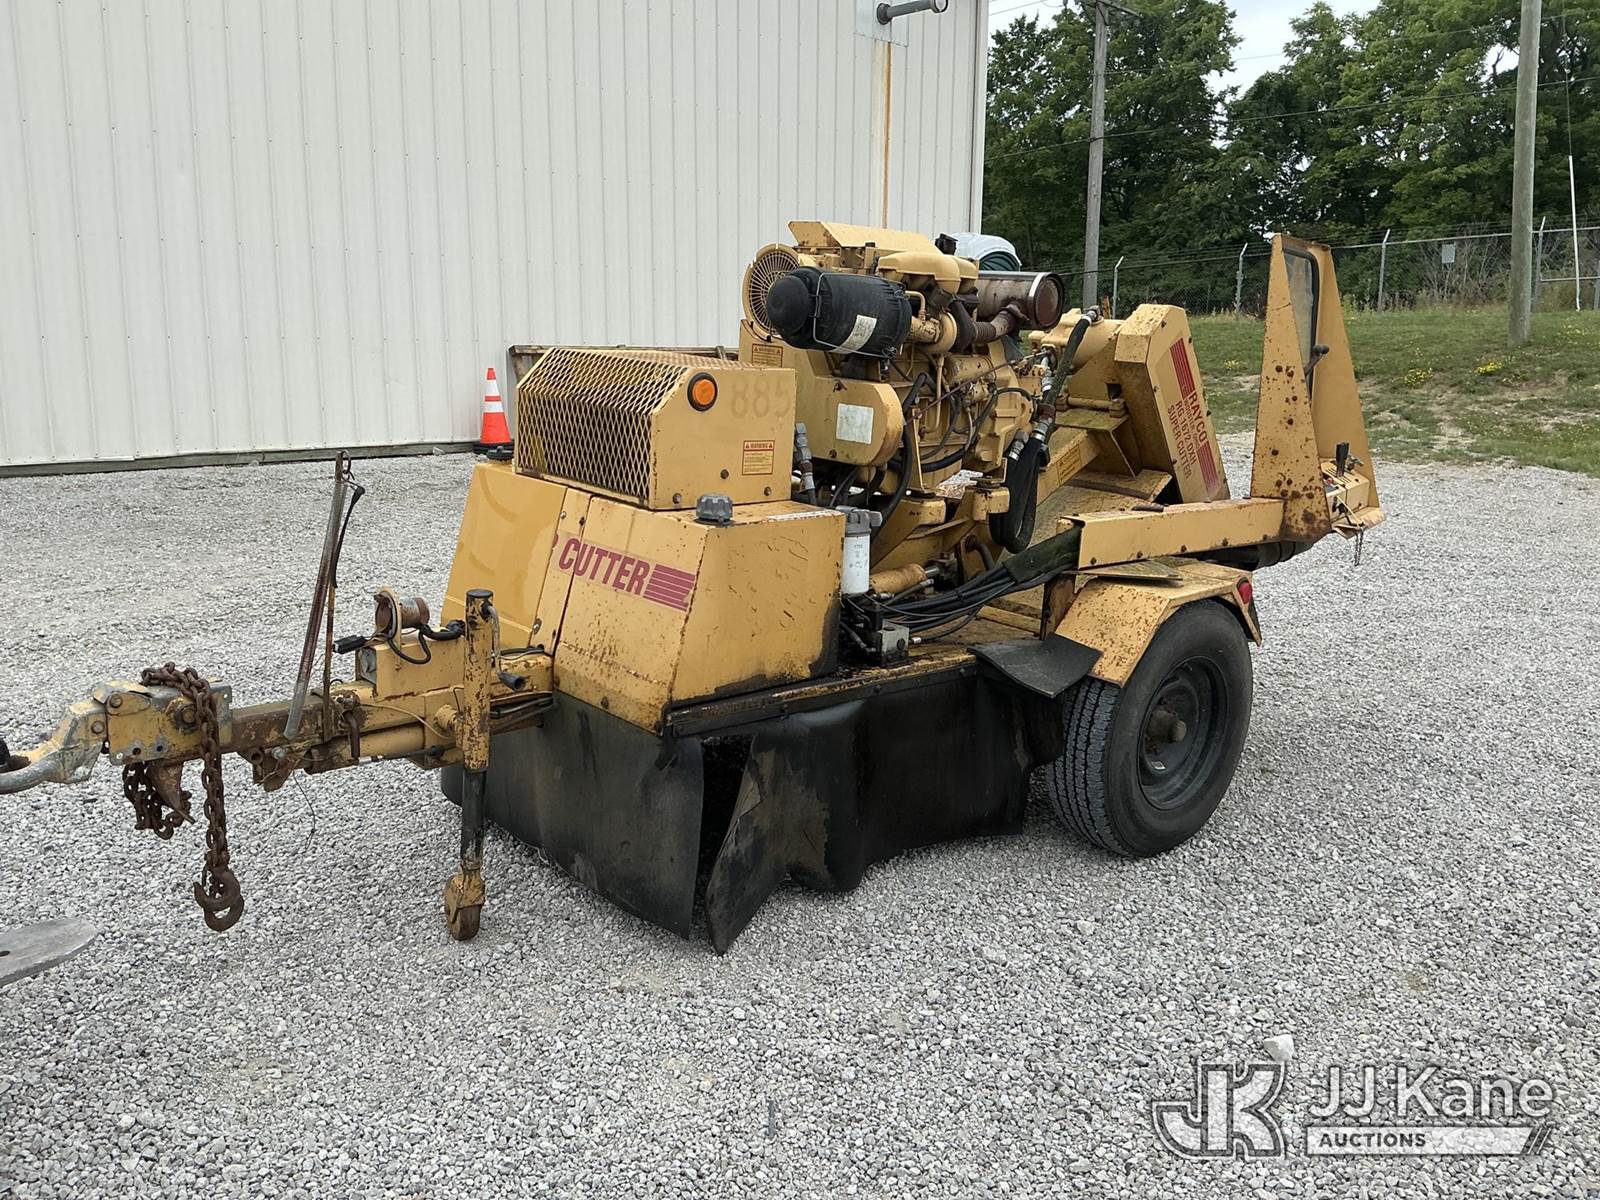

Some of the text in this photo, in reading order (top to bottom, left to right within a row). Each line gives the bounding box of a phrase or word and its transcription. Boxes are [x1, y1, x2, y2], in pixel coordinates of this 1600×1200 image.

[1176, 400, 1185, 417] RG
[1188, 391, 1208, 442] RAYCO
[1167, 404, 1192, 480] SUPER CUTTER
[558, 537, 651, 596] CUTTER
